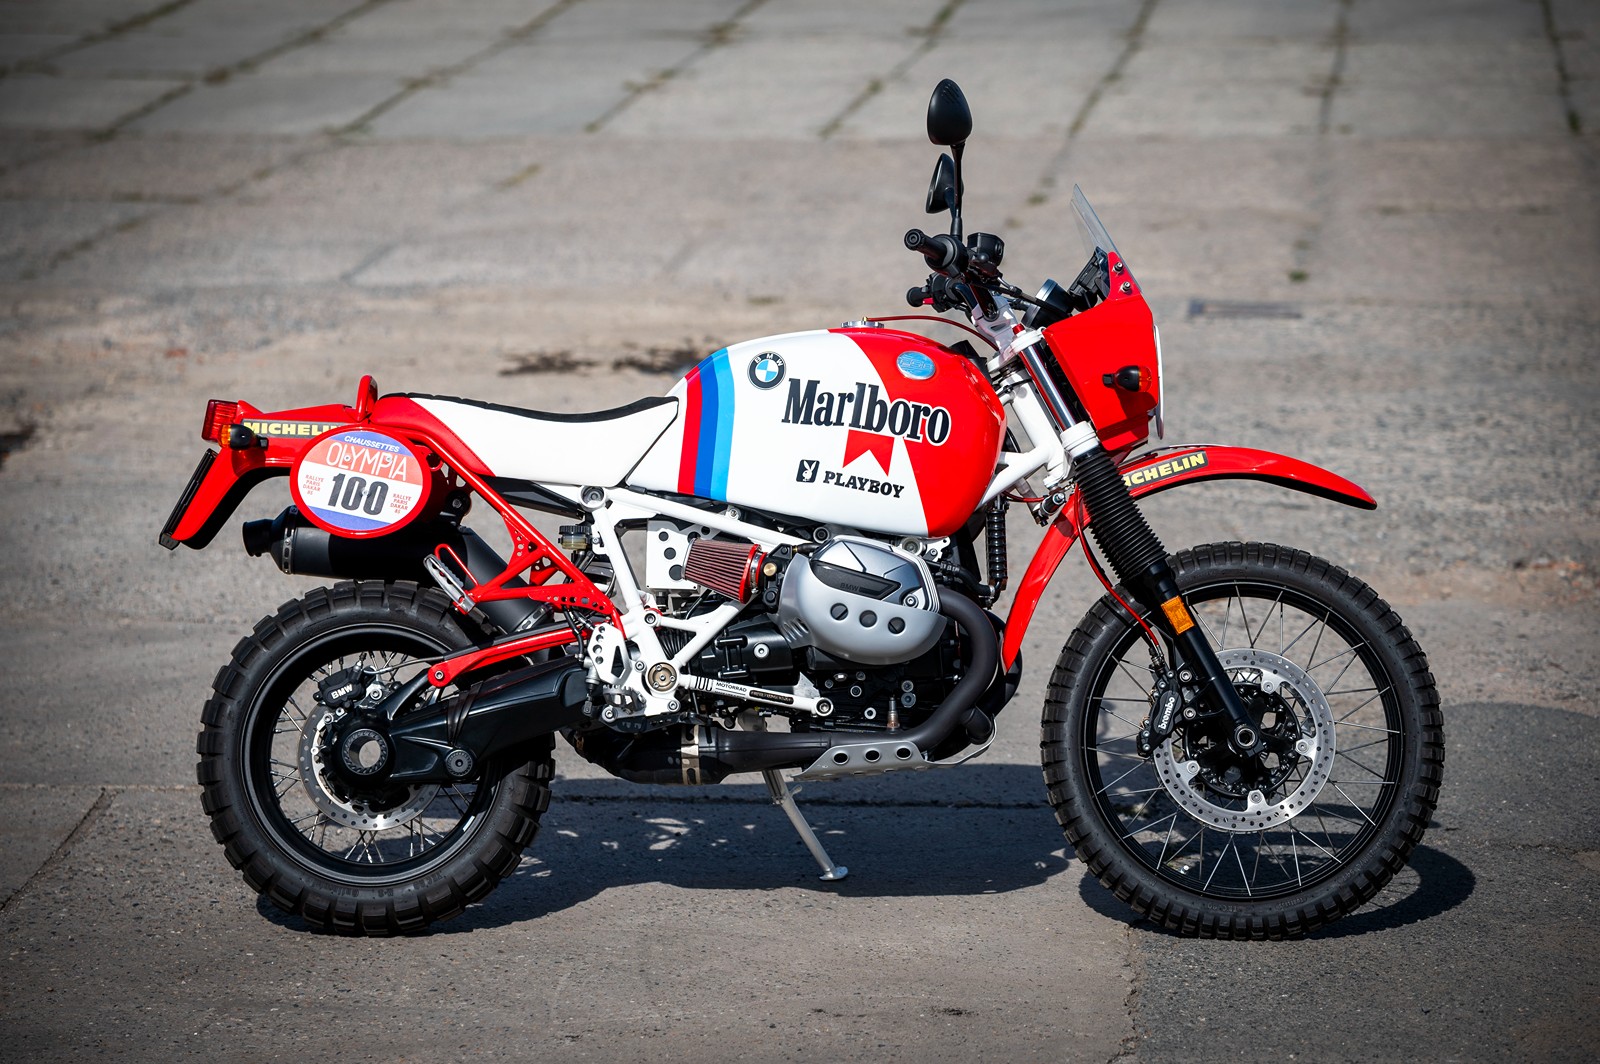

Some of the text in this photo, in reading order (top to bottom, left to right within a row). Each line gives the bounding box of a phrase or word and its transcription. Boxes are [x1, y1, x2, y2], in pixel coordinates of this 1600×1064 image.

[754, 353, 784, 367] BMW
[781, 378, 950, 444] Marlboro
[243, 422, 338, 436] MICHELI
[344, 435, 400, 453] CHAUSSETTES
[326, 442, 407, 481] OLYMPIA
[1123, 453, 1205, 487] ICHELIN
[303, 484, 321, 492] DAKAR
[823, 470, 905, 498] PLAYBOY
[328, 473, 388, 516] 100
[390, 502, 408, 511] DAKAR
[840, 583, 859, 592] BMW
[331, 683, 353, 700] BMW
[1158, 696, 1175, 730] brembo
